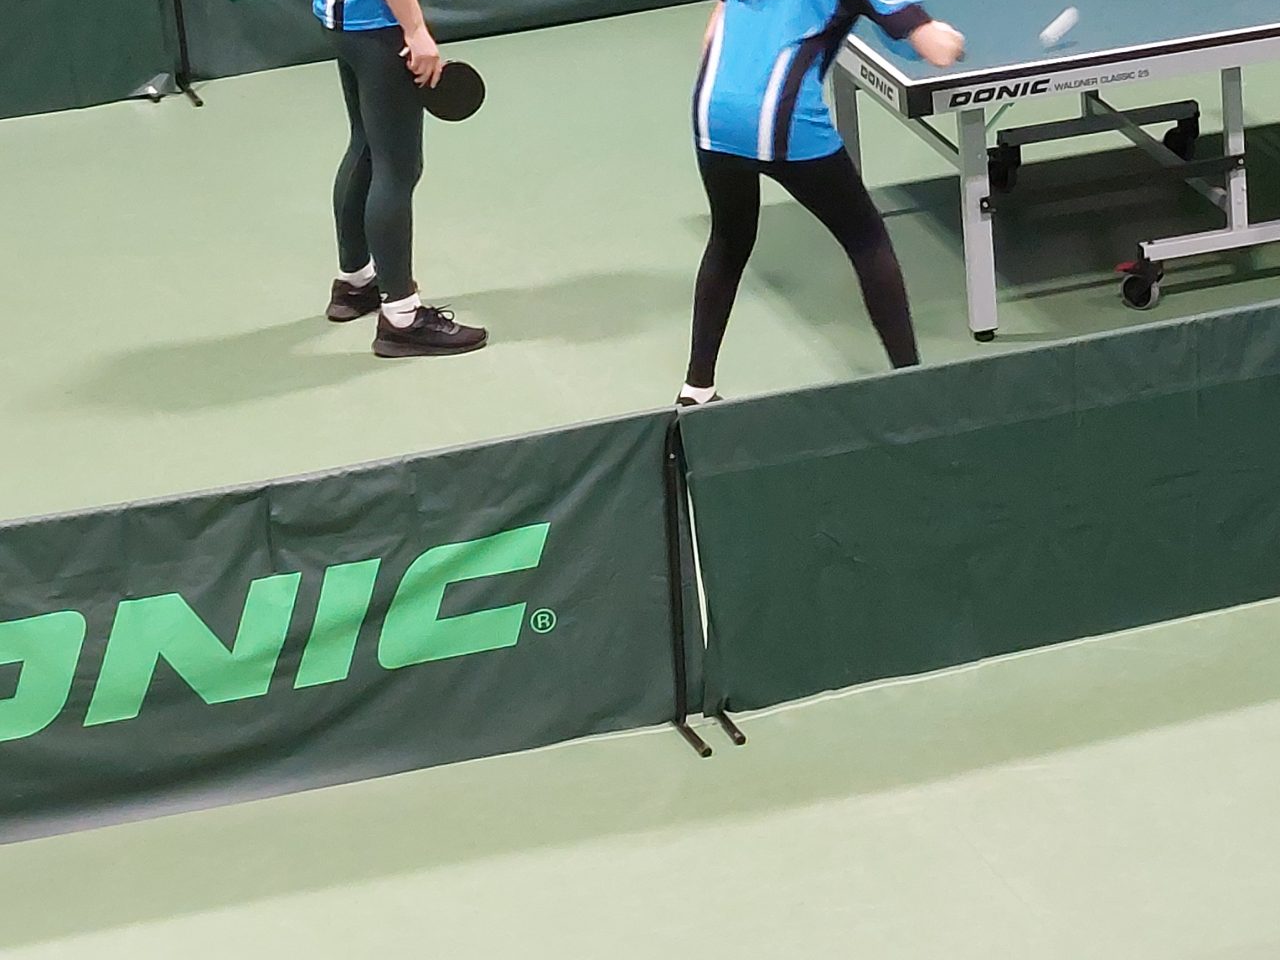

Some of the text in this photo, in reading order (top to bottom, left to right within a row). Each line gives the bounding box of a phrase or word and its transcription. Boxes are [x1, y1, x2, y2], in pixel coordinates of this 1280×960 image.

[860, 64, 895, 102] DONIC
[949, 78, 1051, 108] DONIC
[1054, 76, 1099, 91] WALDNER
[1101, 70, 1136, 85] CLASSIC
